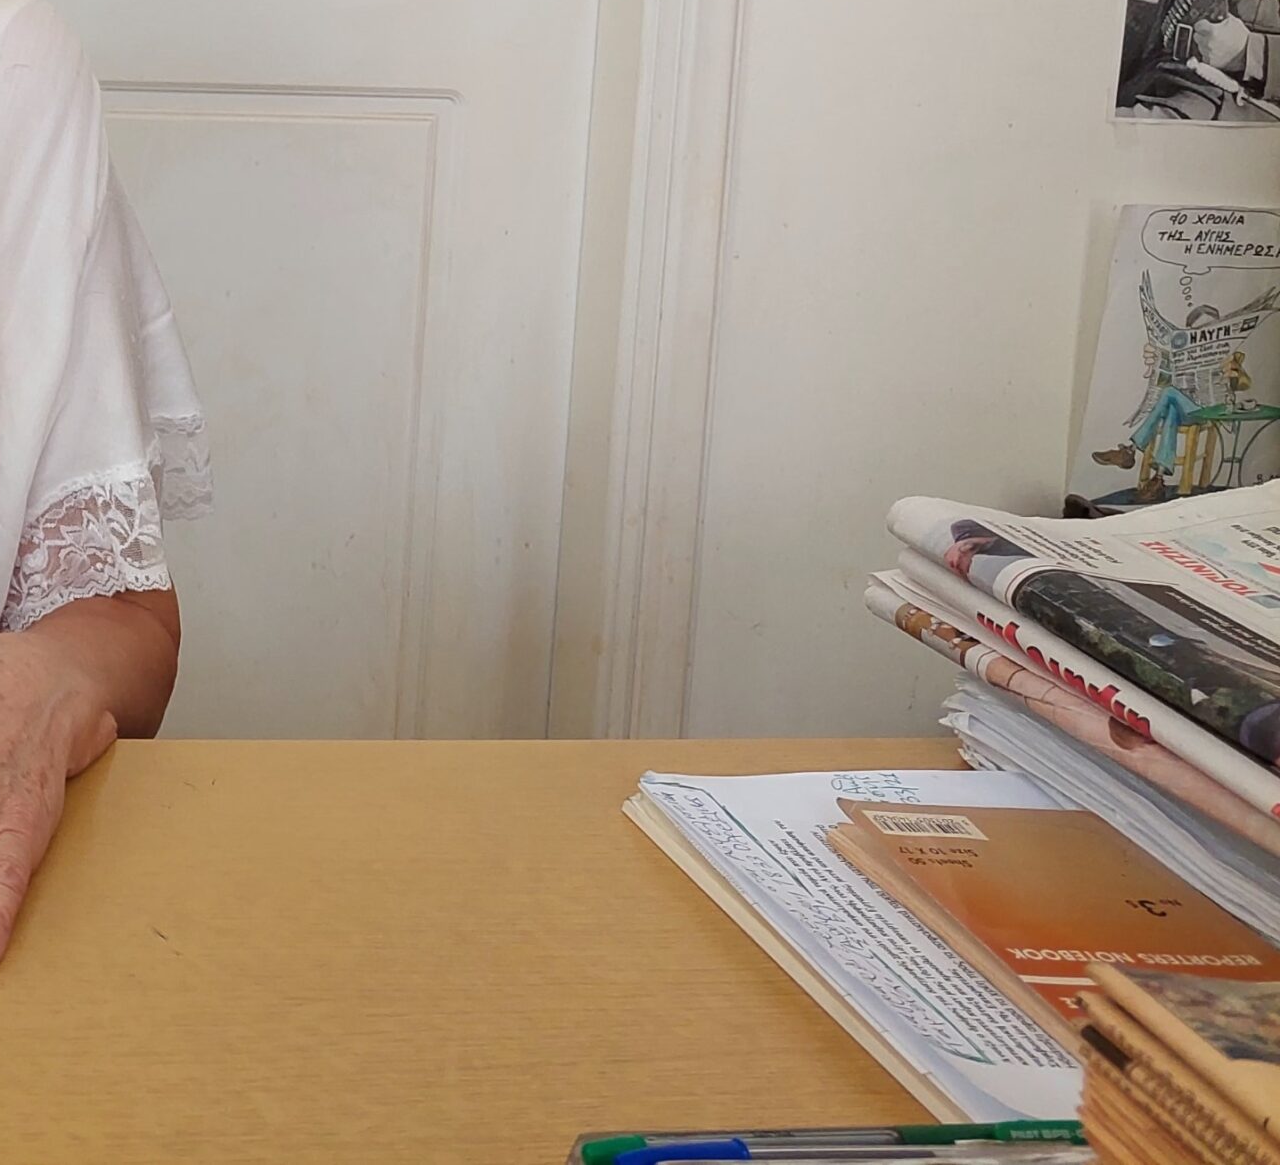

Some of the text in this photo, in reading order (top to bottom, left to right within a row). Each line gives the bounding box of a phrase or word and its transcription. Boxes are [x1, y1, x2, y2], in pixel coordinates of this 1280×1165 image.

[1192, 212, 1244, 225] ΧΡΟΝΙΑ
[1158, 229, 1235, 243] ΤΗΣ ΑΥΓΗΣ
[1007, 947, 1262, 967] REPORTERS NOTEBOOK
